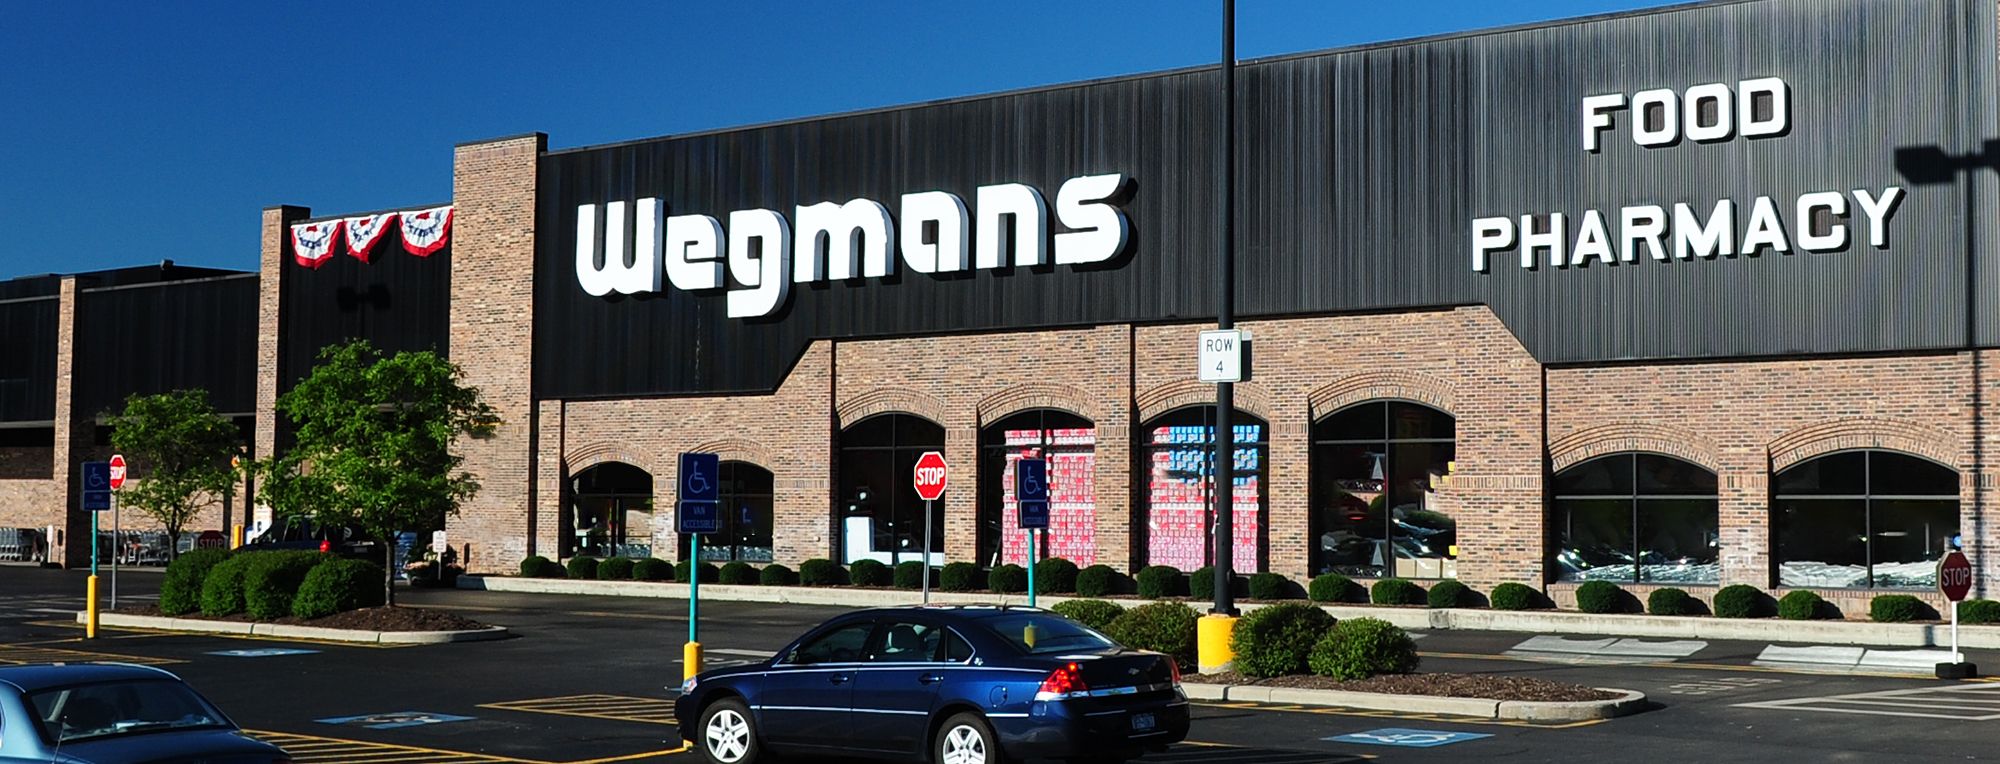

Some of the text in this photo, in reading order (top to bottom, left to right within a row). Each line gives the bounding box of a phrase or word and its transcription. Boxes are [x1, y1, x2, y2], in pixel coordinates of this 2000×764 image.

[1582, 77, 1788, 152] FOOD
[1472, 187, 1901, 271] PHARMACY
[576, 173, 1127, 318] Wegmans
[1206, 338, 1233, 352] ROW
[1215, 360, 1224, 373] 4
[916, 467, 945, 486] STOP
[199, 538, 224, 549] STOP
[1942, 567, 1970, 587] STOP
